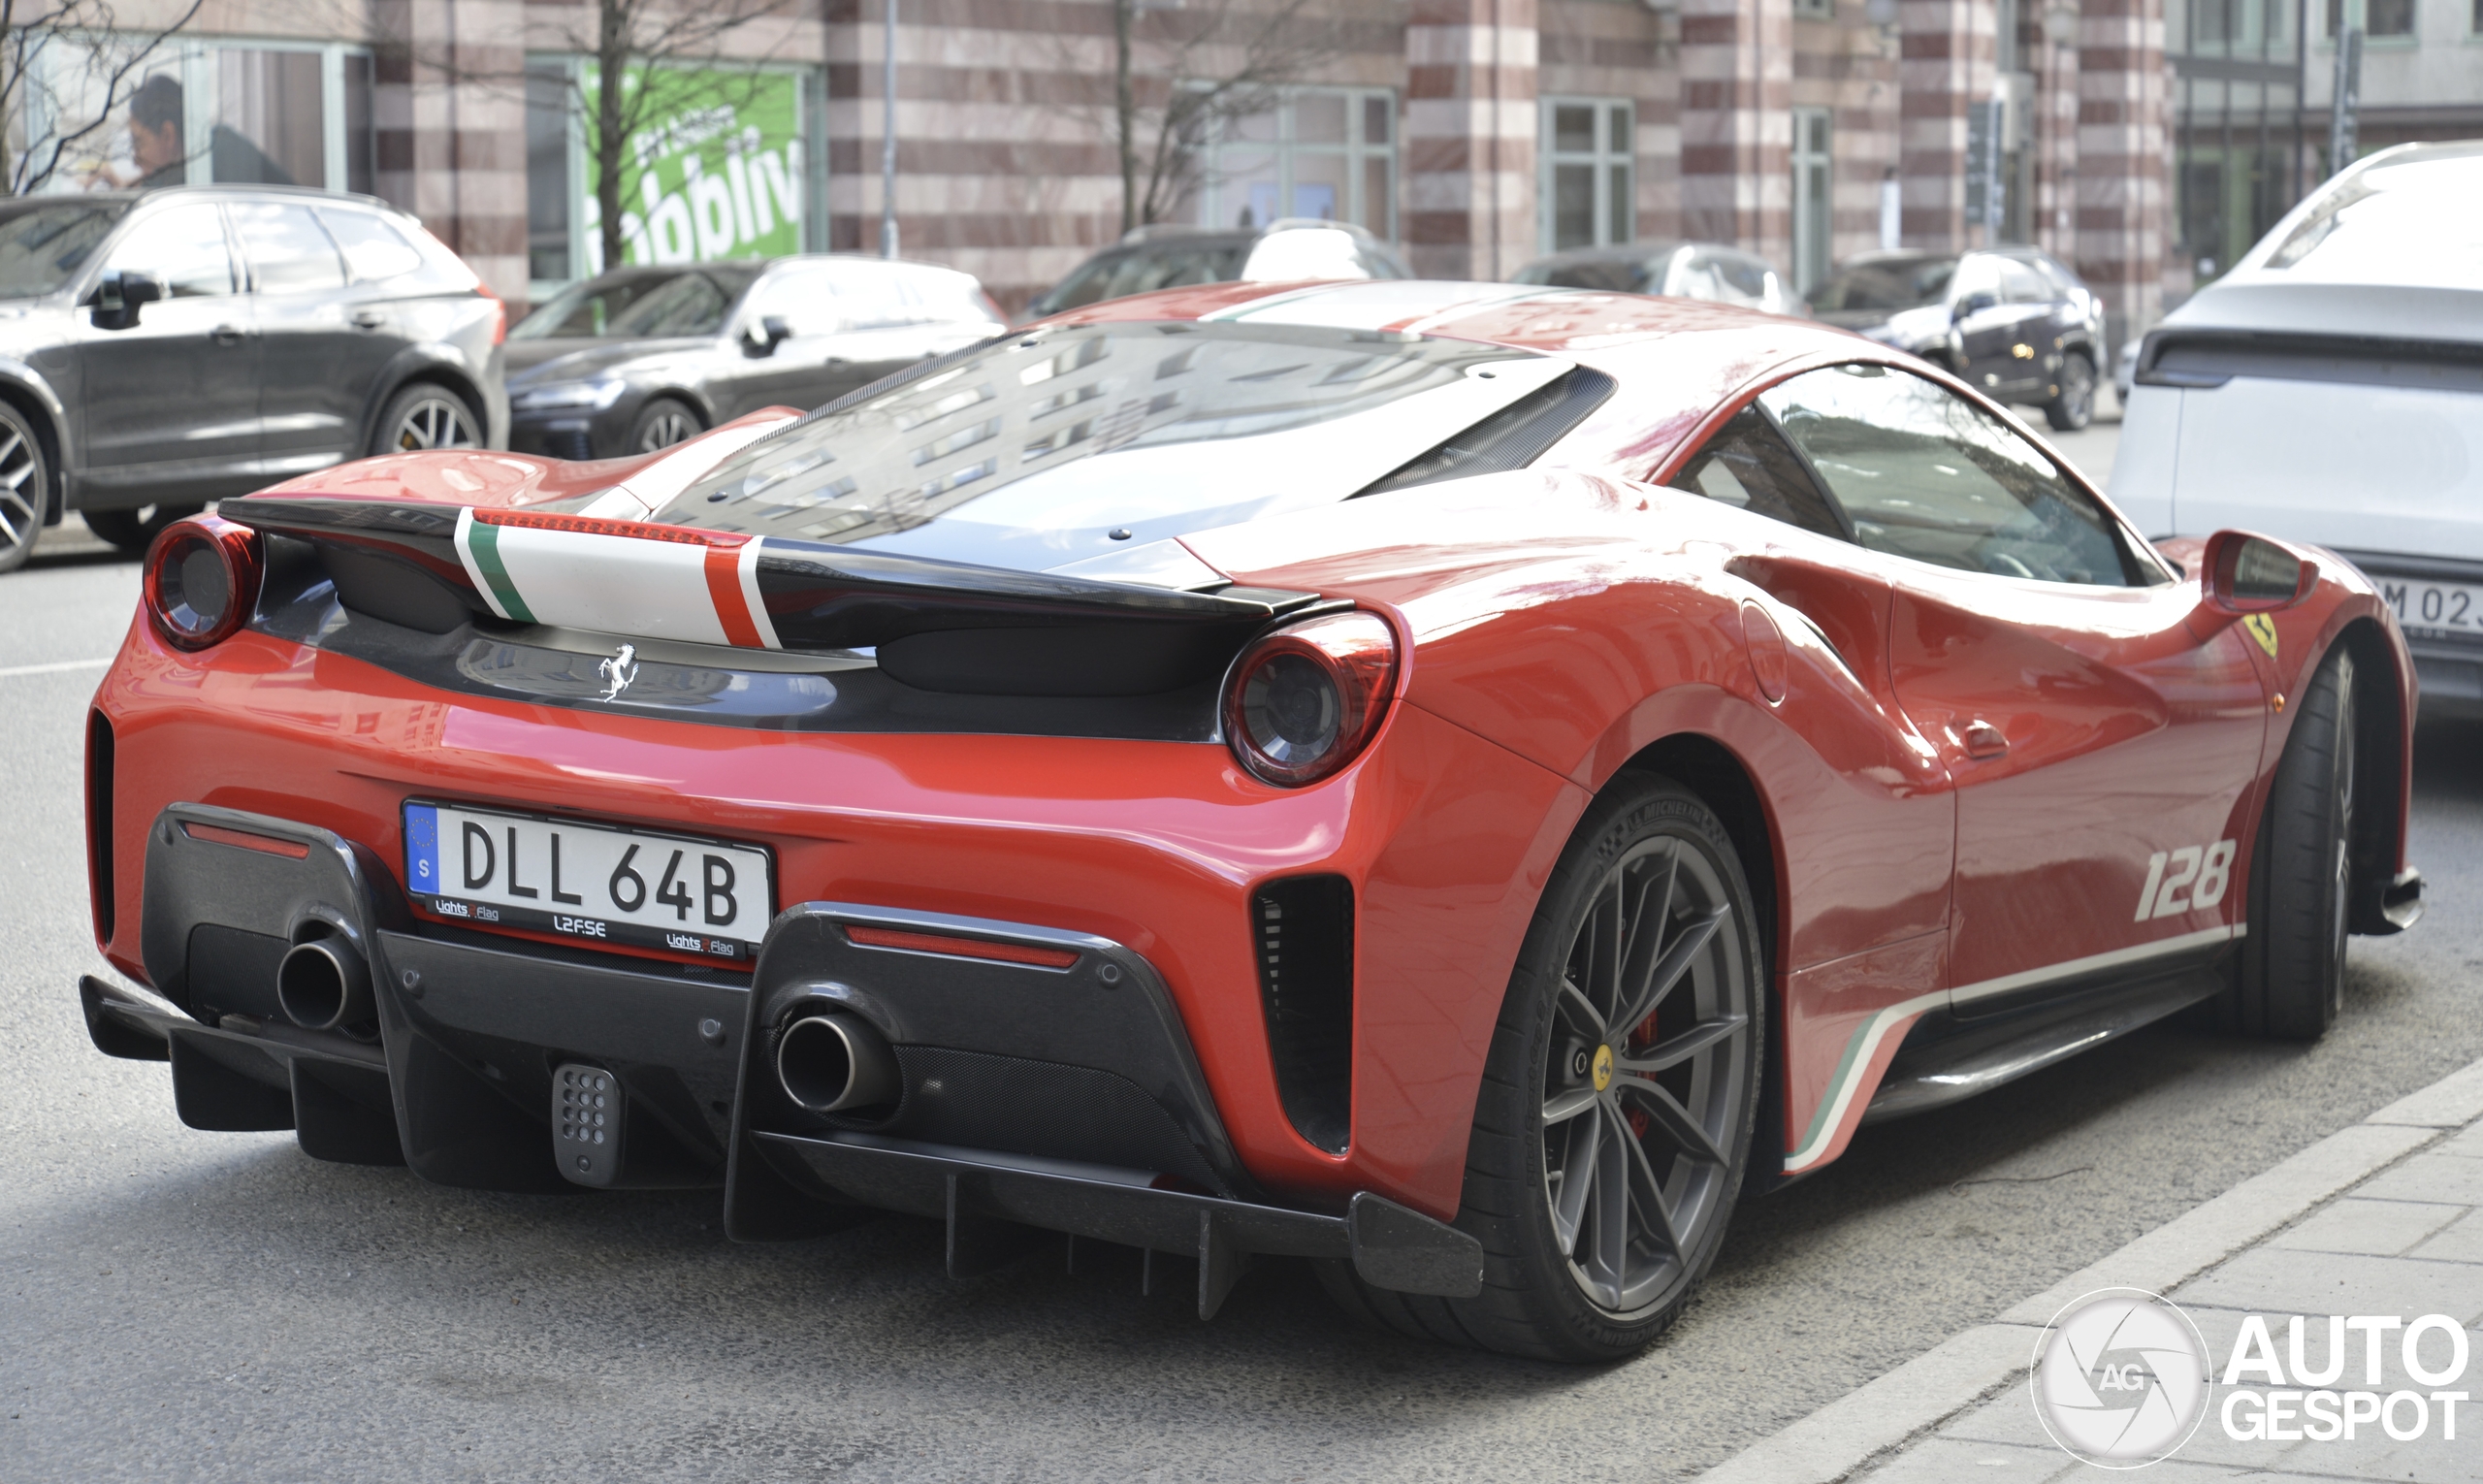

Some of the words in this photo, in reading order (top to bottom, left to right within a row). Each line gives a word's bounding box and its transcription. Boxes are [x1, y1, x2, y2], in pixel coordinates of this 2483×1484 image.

[1644, 800, 1703, 823] MICHELIN
[418, 858, 430, 878] S
[462, 821, 583, 907] DLL
[608, 843, 738, 926] 64B
[2134, 838, 2237, 922] 128
